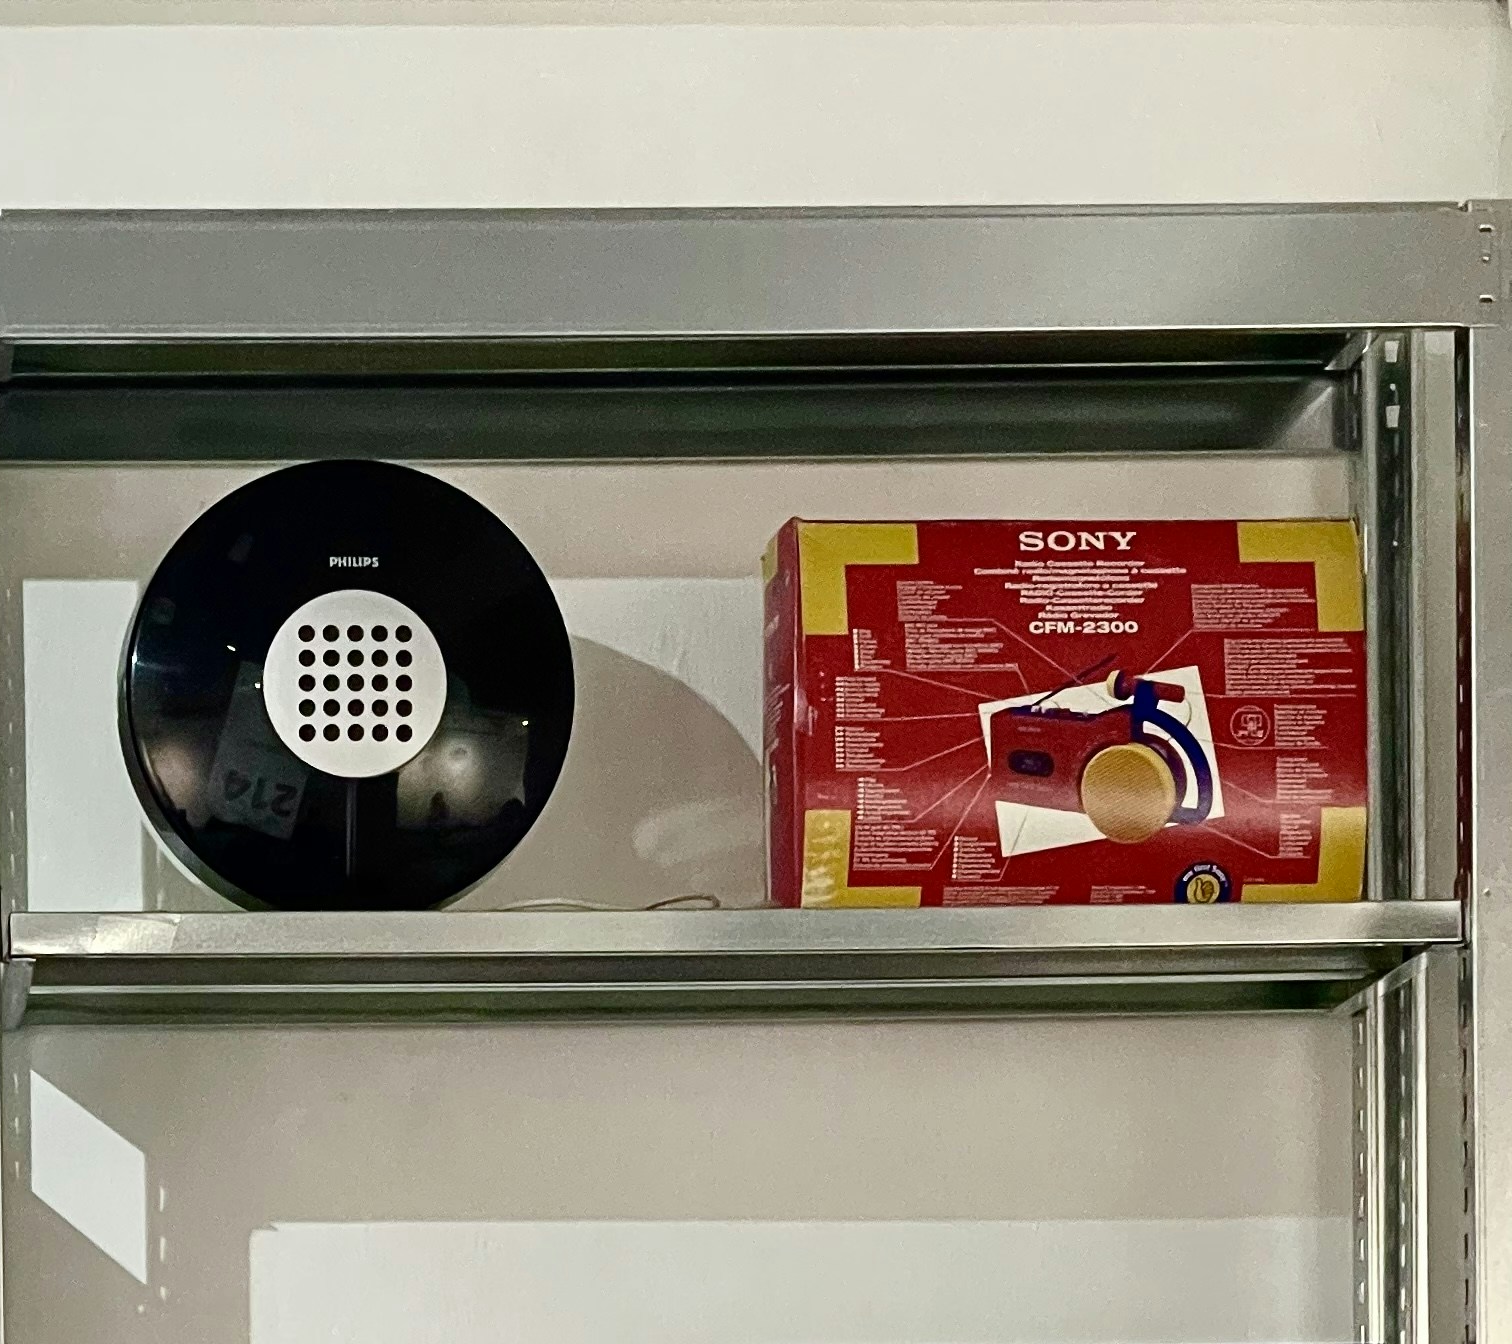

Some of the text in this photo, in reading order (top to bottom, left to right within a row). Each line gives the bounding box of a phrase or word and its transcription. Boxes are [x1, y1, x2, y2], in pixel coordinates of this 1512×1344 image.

[1019, 531, 1137, 551] SONY
[329, 556, 379, 568] PHILIPS
[1029, 621, 1139, 634] CFM-2300
